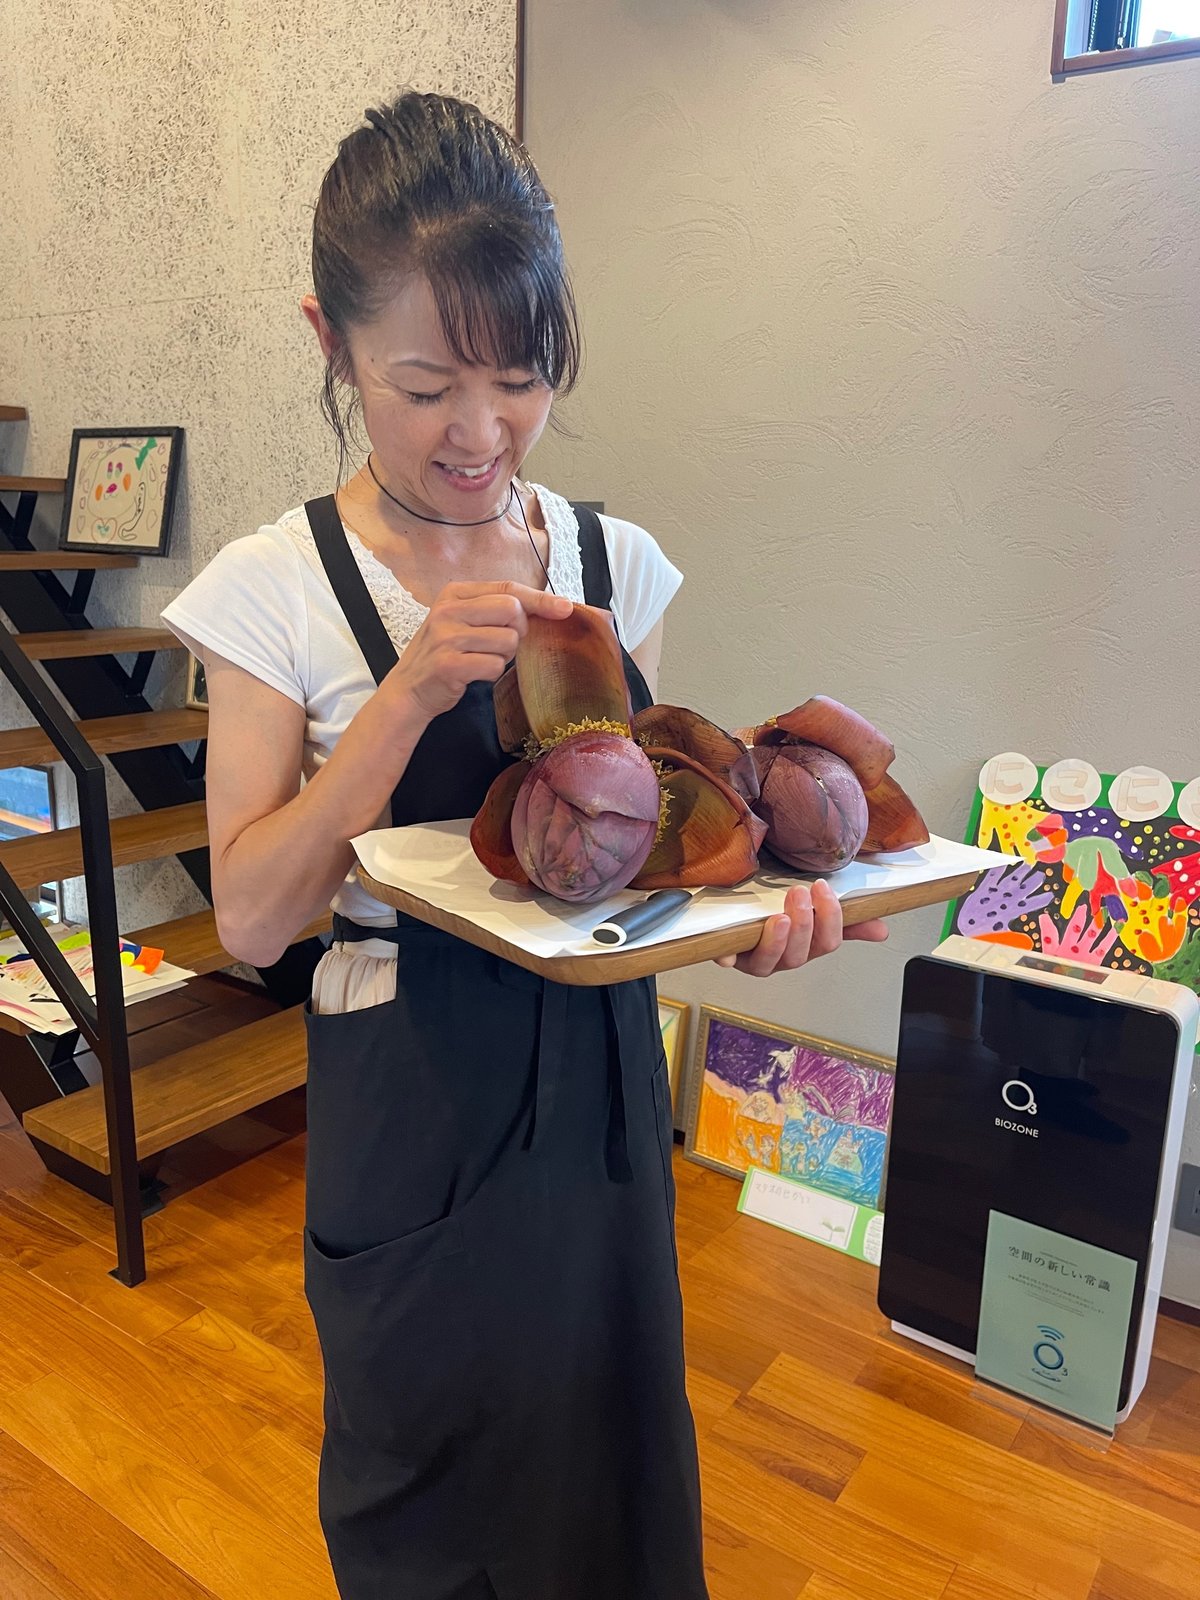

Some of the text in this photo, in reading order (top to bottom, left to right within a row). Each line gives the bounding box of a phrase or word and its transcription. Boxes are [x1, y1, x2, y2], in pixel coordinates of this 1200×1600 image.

[984, 762, 1200, 819] にこに
[995, 1117, 1039, 1138] BIOZONE
[1008, 1246, 1111, 1292] 空間の新しい常識
